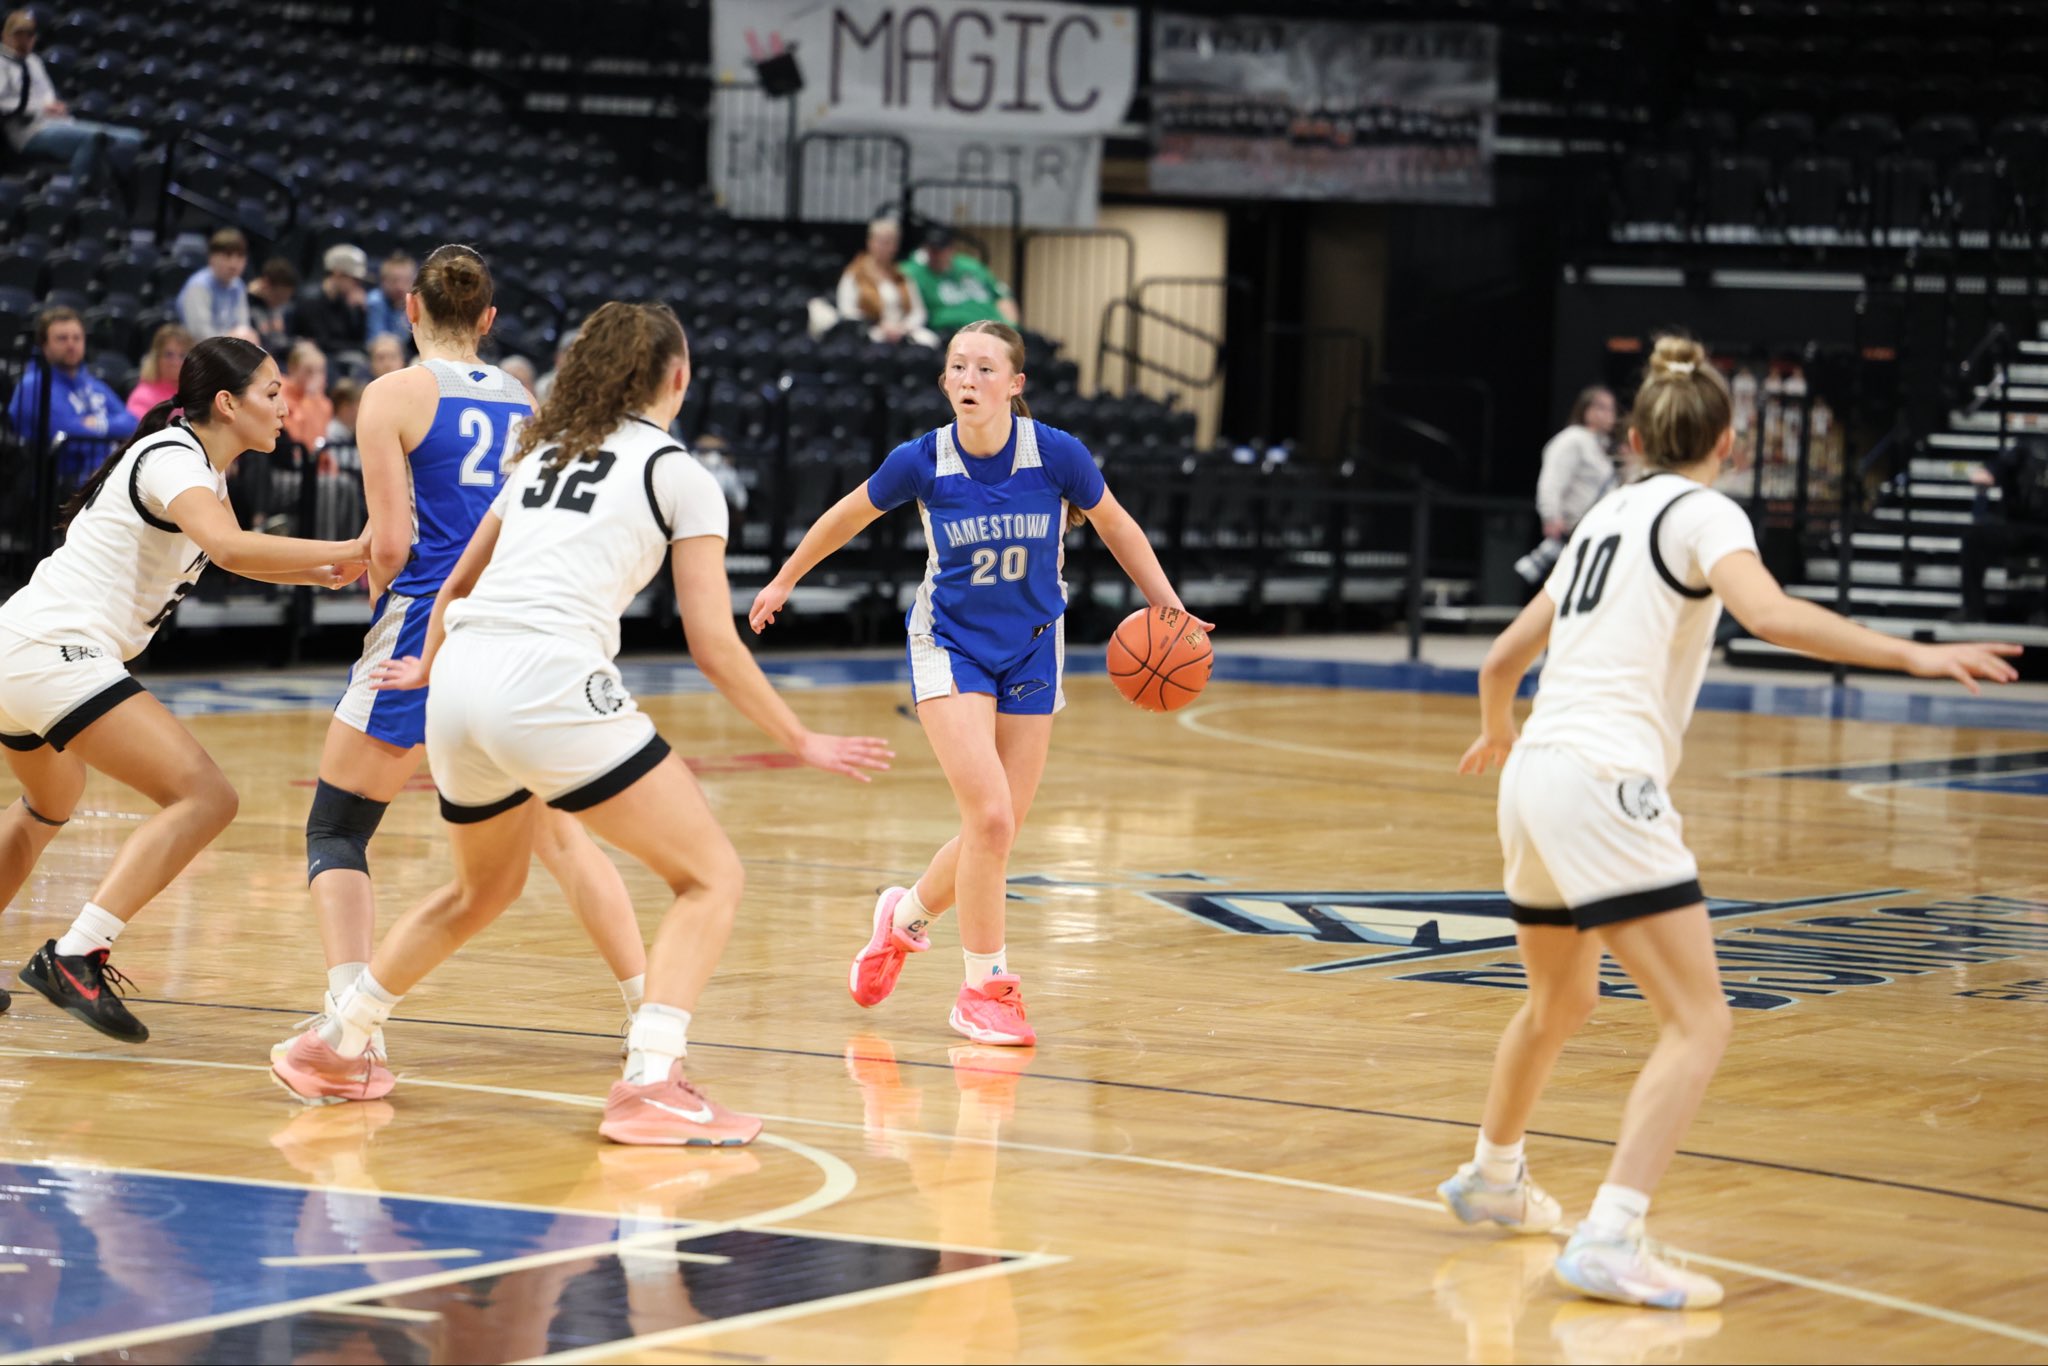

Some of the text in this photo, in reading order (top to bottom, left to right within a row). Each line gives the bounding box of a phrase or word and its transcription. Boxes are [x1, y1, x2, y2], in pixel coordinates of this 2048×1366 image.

[829, 7, 1101, 114] MAGIC
[521, 447, 617, 514] 32
[942, 513, 1051, 548] JAMESTOWN
[970, 545, 1028, 586] 20
[1559, 533, 1621, 619] 10
